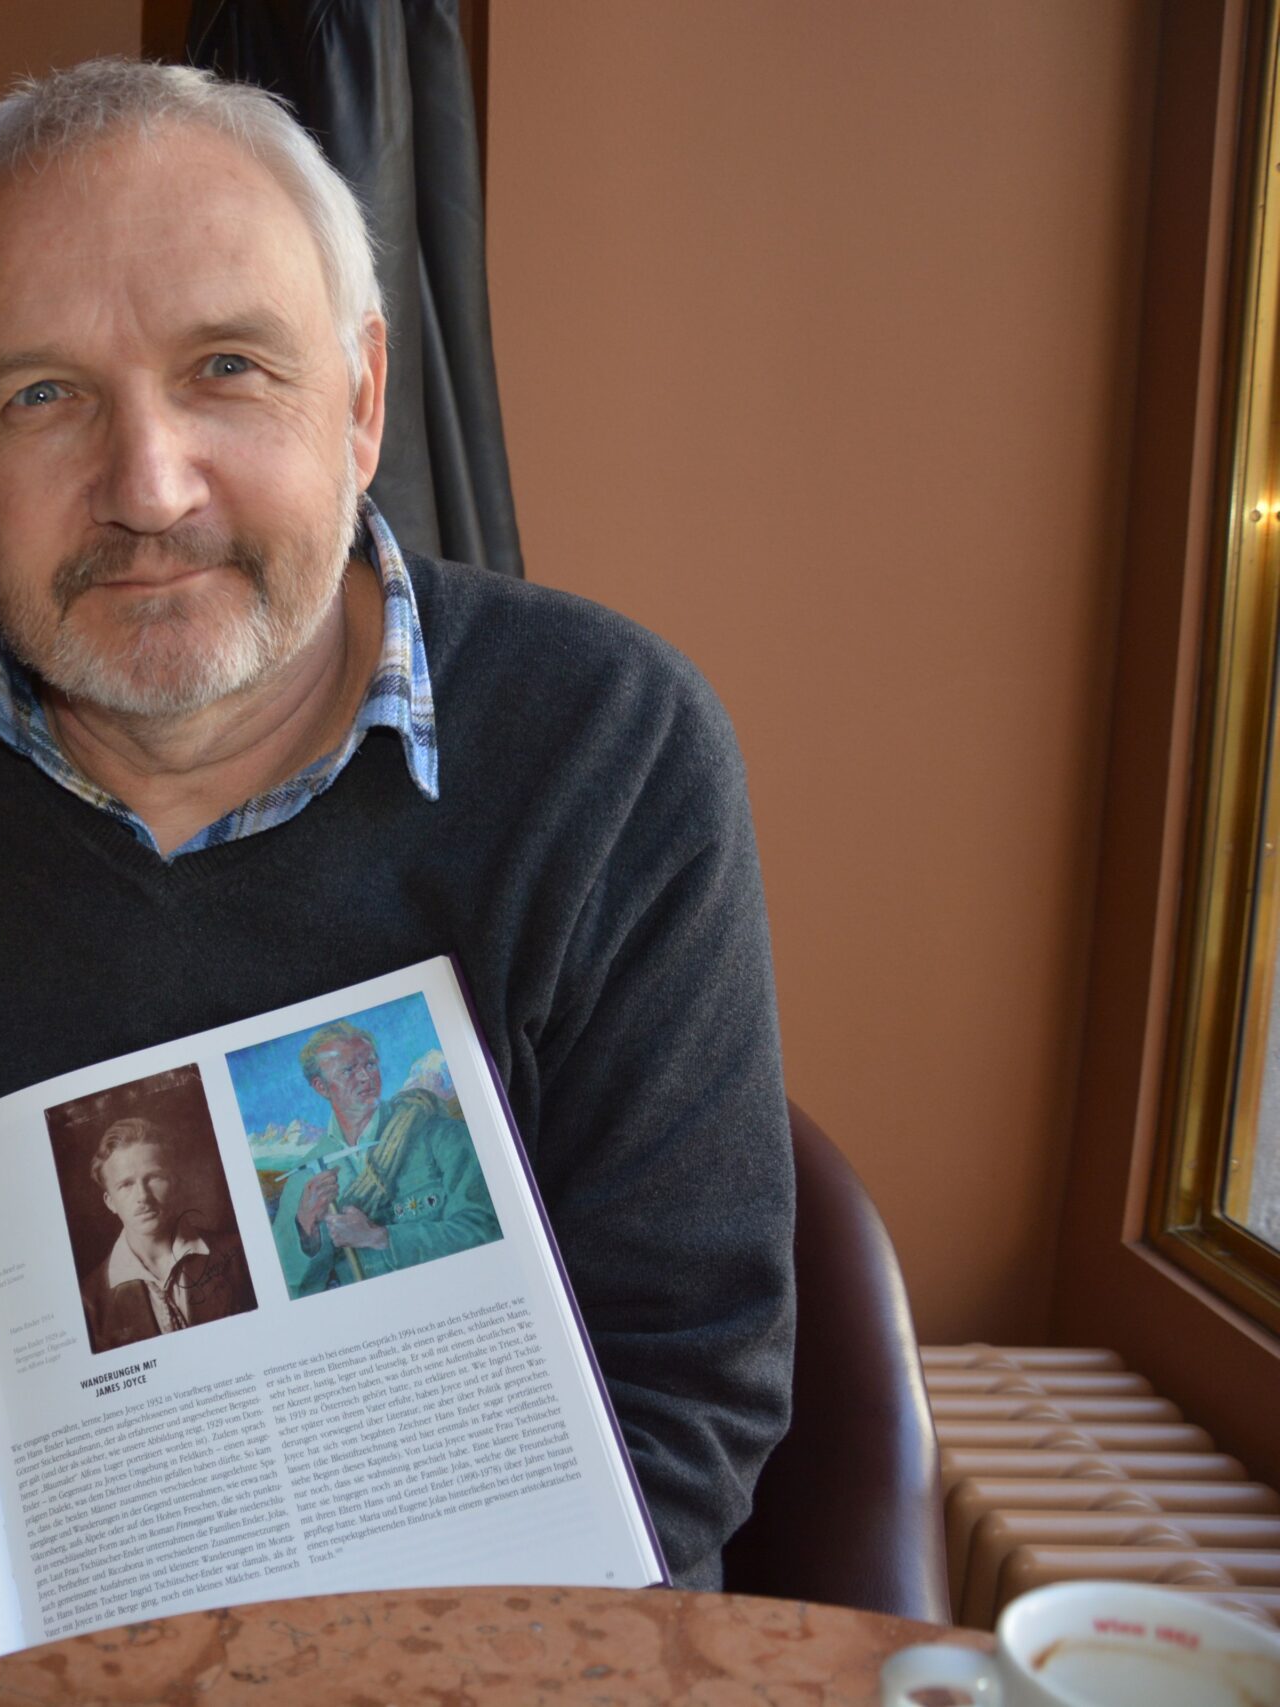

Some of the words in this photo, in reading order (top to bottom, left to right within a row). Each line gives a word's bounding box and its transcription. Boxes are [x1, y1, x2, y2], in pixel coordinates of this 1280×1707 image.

[80, 1364, 140, 1389] WANDERUNGEN
[142, 1359, 157, 1371] MIT
[96, 1382, 120, 1398] JAMES
[123, 1374, 147, 1389] JOYCE
